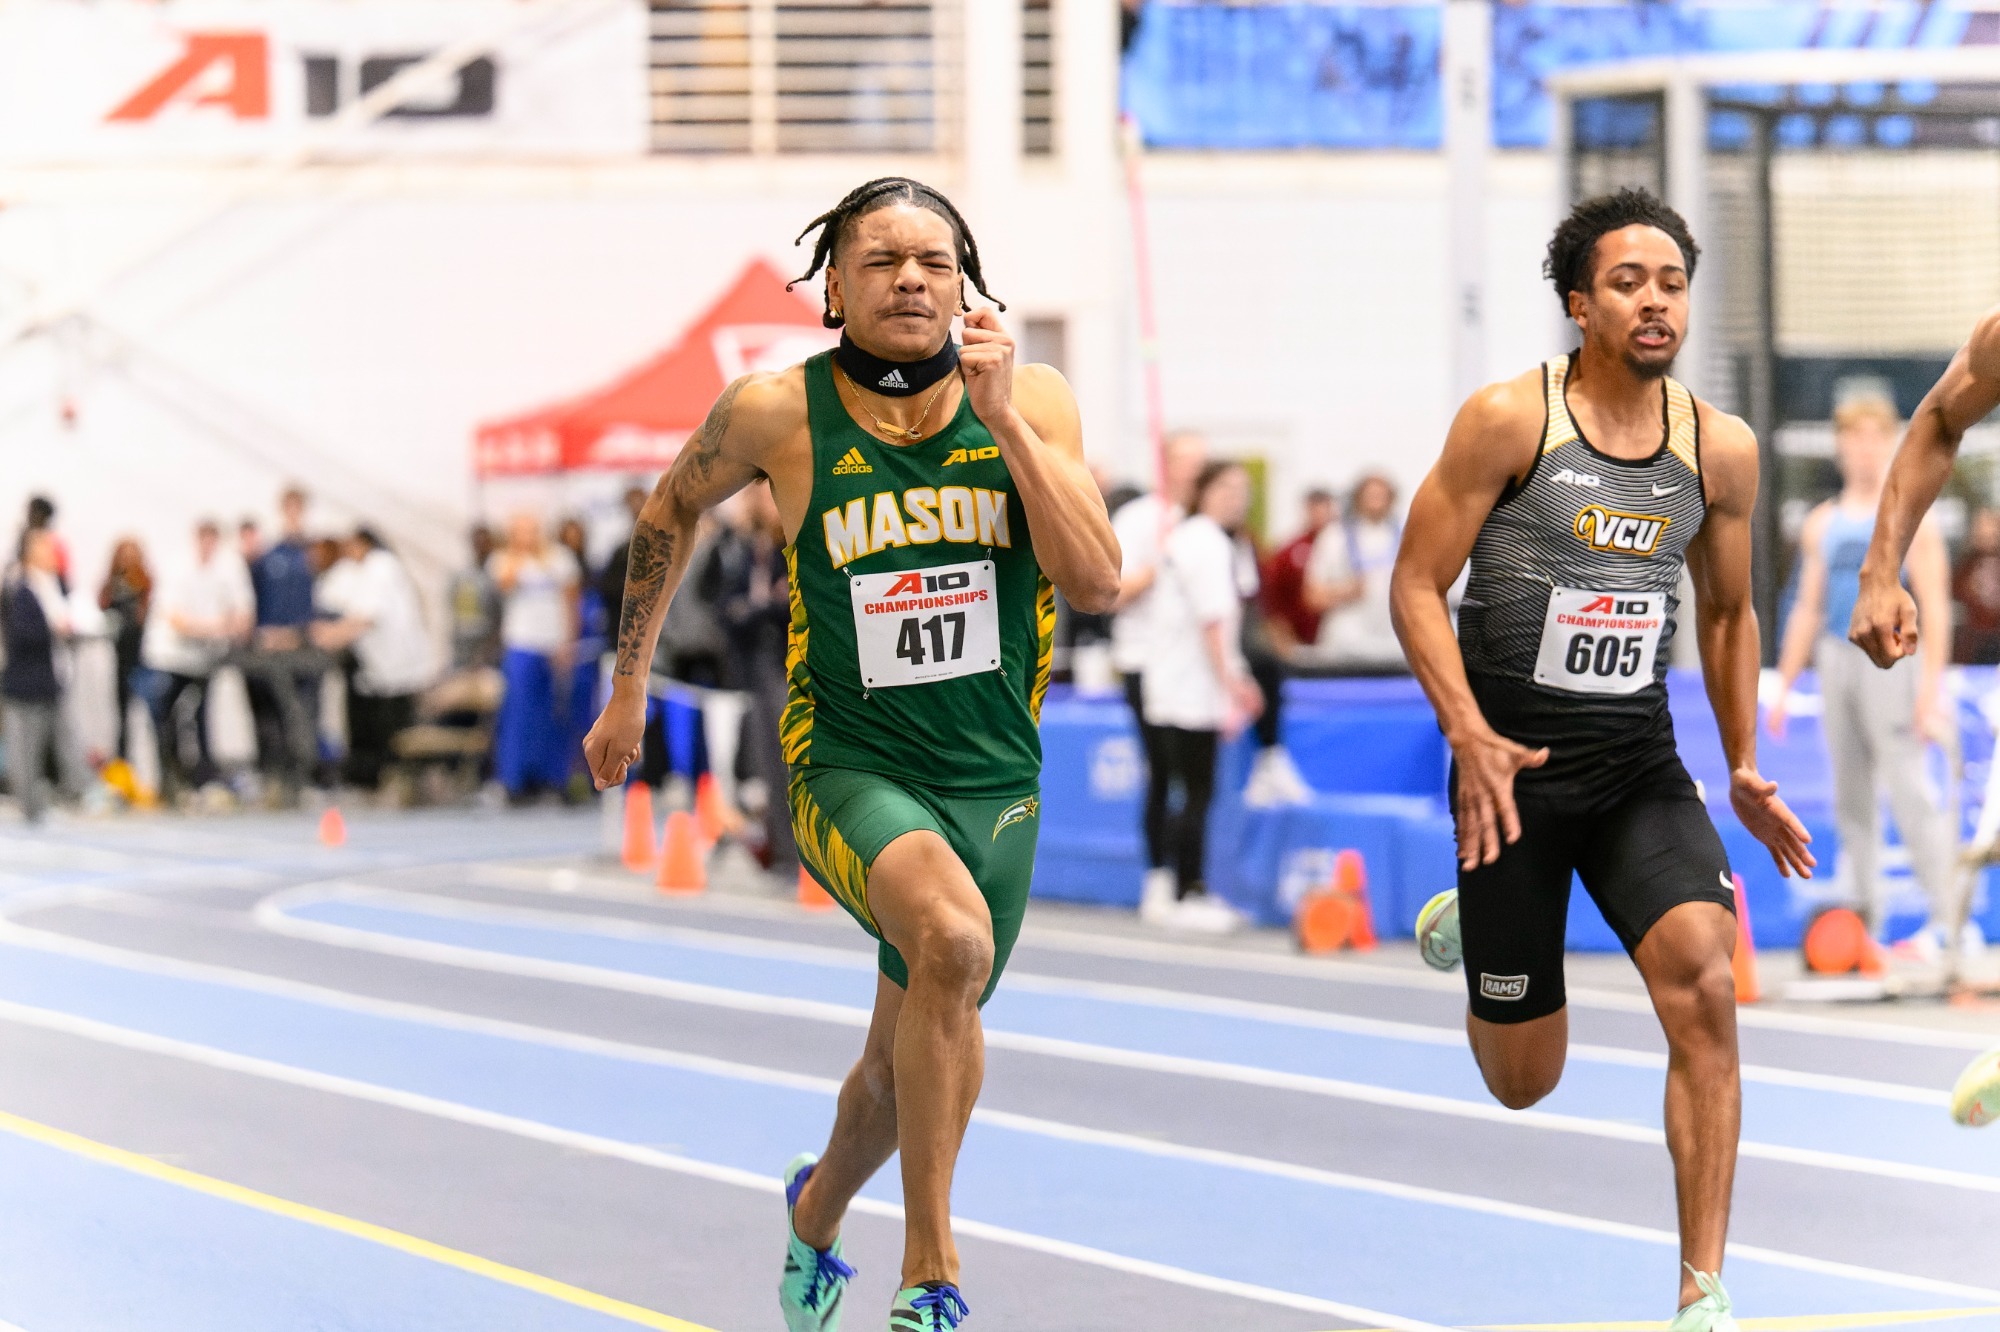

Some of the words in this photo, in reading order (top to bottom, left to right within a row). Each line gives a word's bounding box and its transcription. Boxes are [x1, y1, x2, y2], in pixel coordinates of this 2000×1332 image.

[104, 32, 498, 122] A10
[878, 379, 909, 390] adidas
[941, 446, 1000, 466] A10
[832, 463, 873, 475] adidas
[1550, 469, 1600, 486] A10
[822, 487, 1011, 570] MASON
[1576, 506, 1667, 554] VCU
[883, 572, 970, 597] A10
[864, 591, 988, 615] CHAMPIONSHIPS
[1577, 595, 1649, 615] A10
[1556, 614, 1658, 630] CHAMPIONSHIPS
[896, 611, 966, 666] 417
[1565, 633, 1643, 677] 605
[1485, 979, 1523, 995] RAMS
